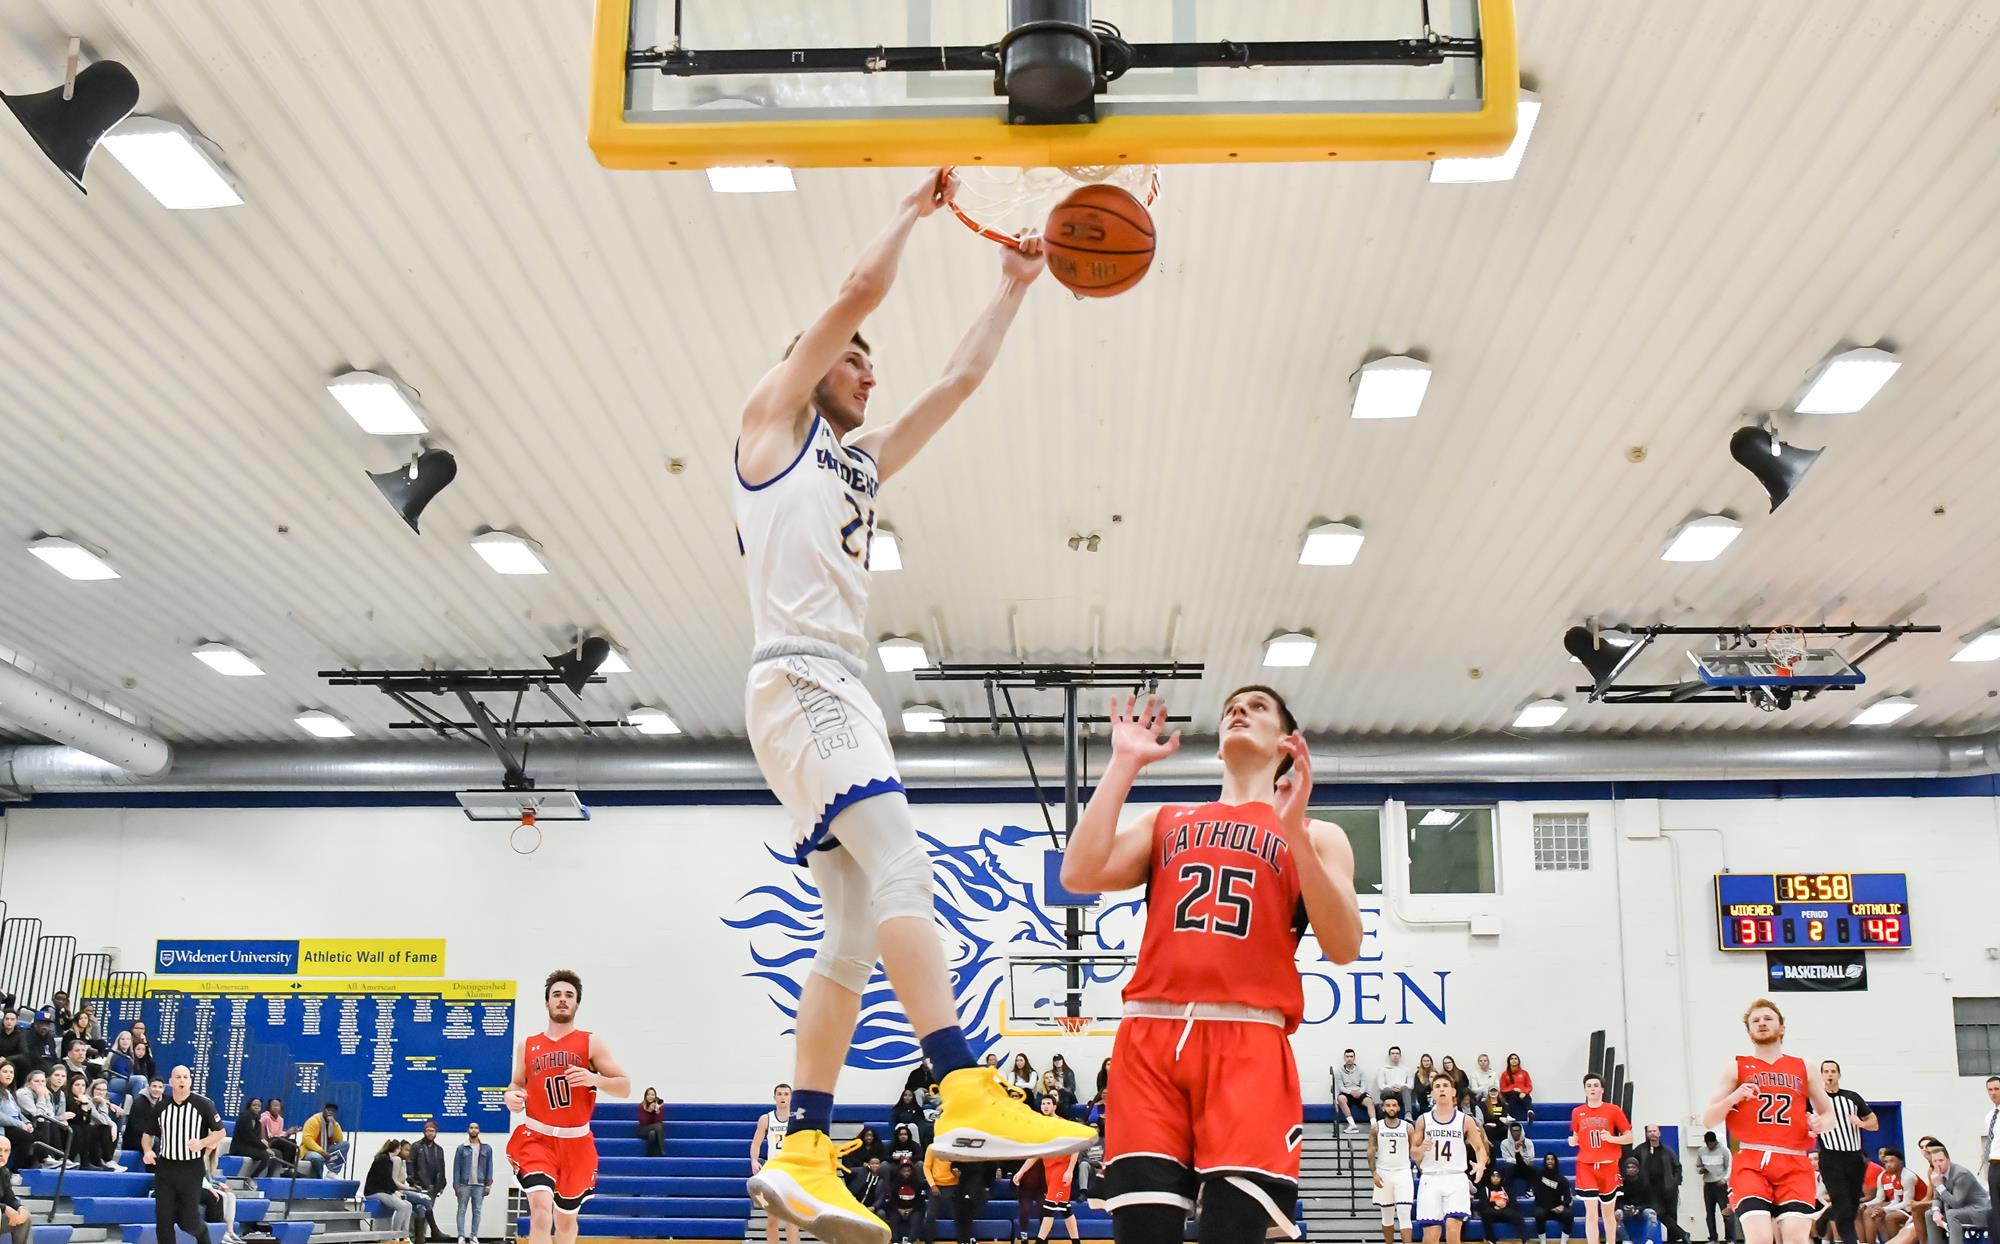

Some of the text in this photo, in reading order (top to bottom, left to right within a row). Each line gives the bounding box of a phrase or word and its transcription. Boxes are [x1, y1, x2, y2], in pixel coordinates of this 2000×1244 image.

[1161, 820, 1288, 876] CATHOLIC
[1787, 875, 1849, 900] 15:58
[1173, 862, 1257, 940] 25
[1730, 904, 1774, 917] WIDENER
[1851, 903, 1902, 916] CATHOLIC
[1801, 910, 1829, 919] PERIOD
[1740, 919, 1773, 944] 31
[1809, 920, 1823, 942] 2
[1867, 918, 1900, 942] 42
[175, 950, 292, 967] Widener University
[304, 951, 438, 963] Athletic Wall of Fame
[1783, 964, 1846, 979] BASKETBALL
[544, 1074, 572, 1111] 10
[1757, 1092, 1792, 1126] 22
[1425, 1129, 1462, 1139] WIDENER
[1589, 1129, 1602, 1149] 11
[1388, 1139, 1397, 1154] 3
[1434, 1139, 1453, 1162] 14
